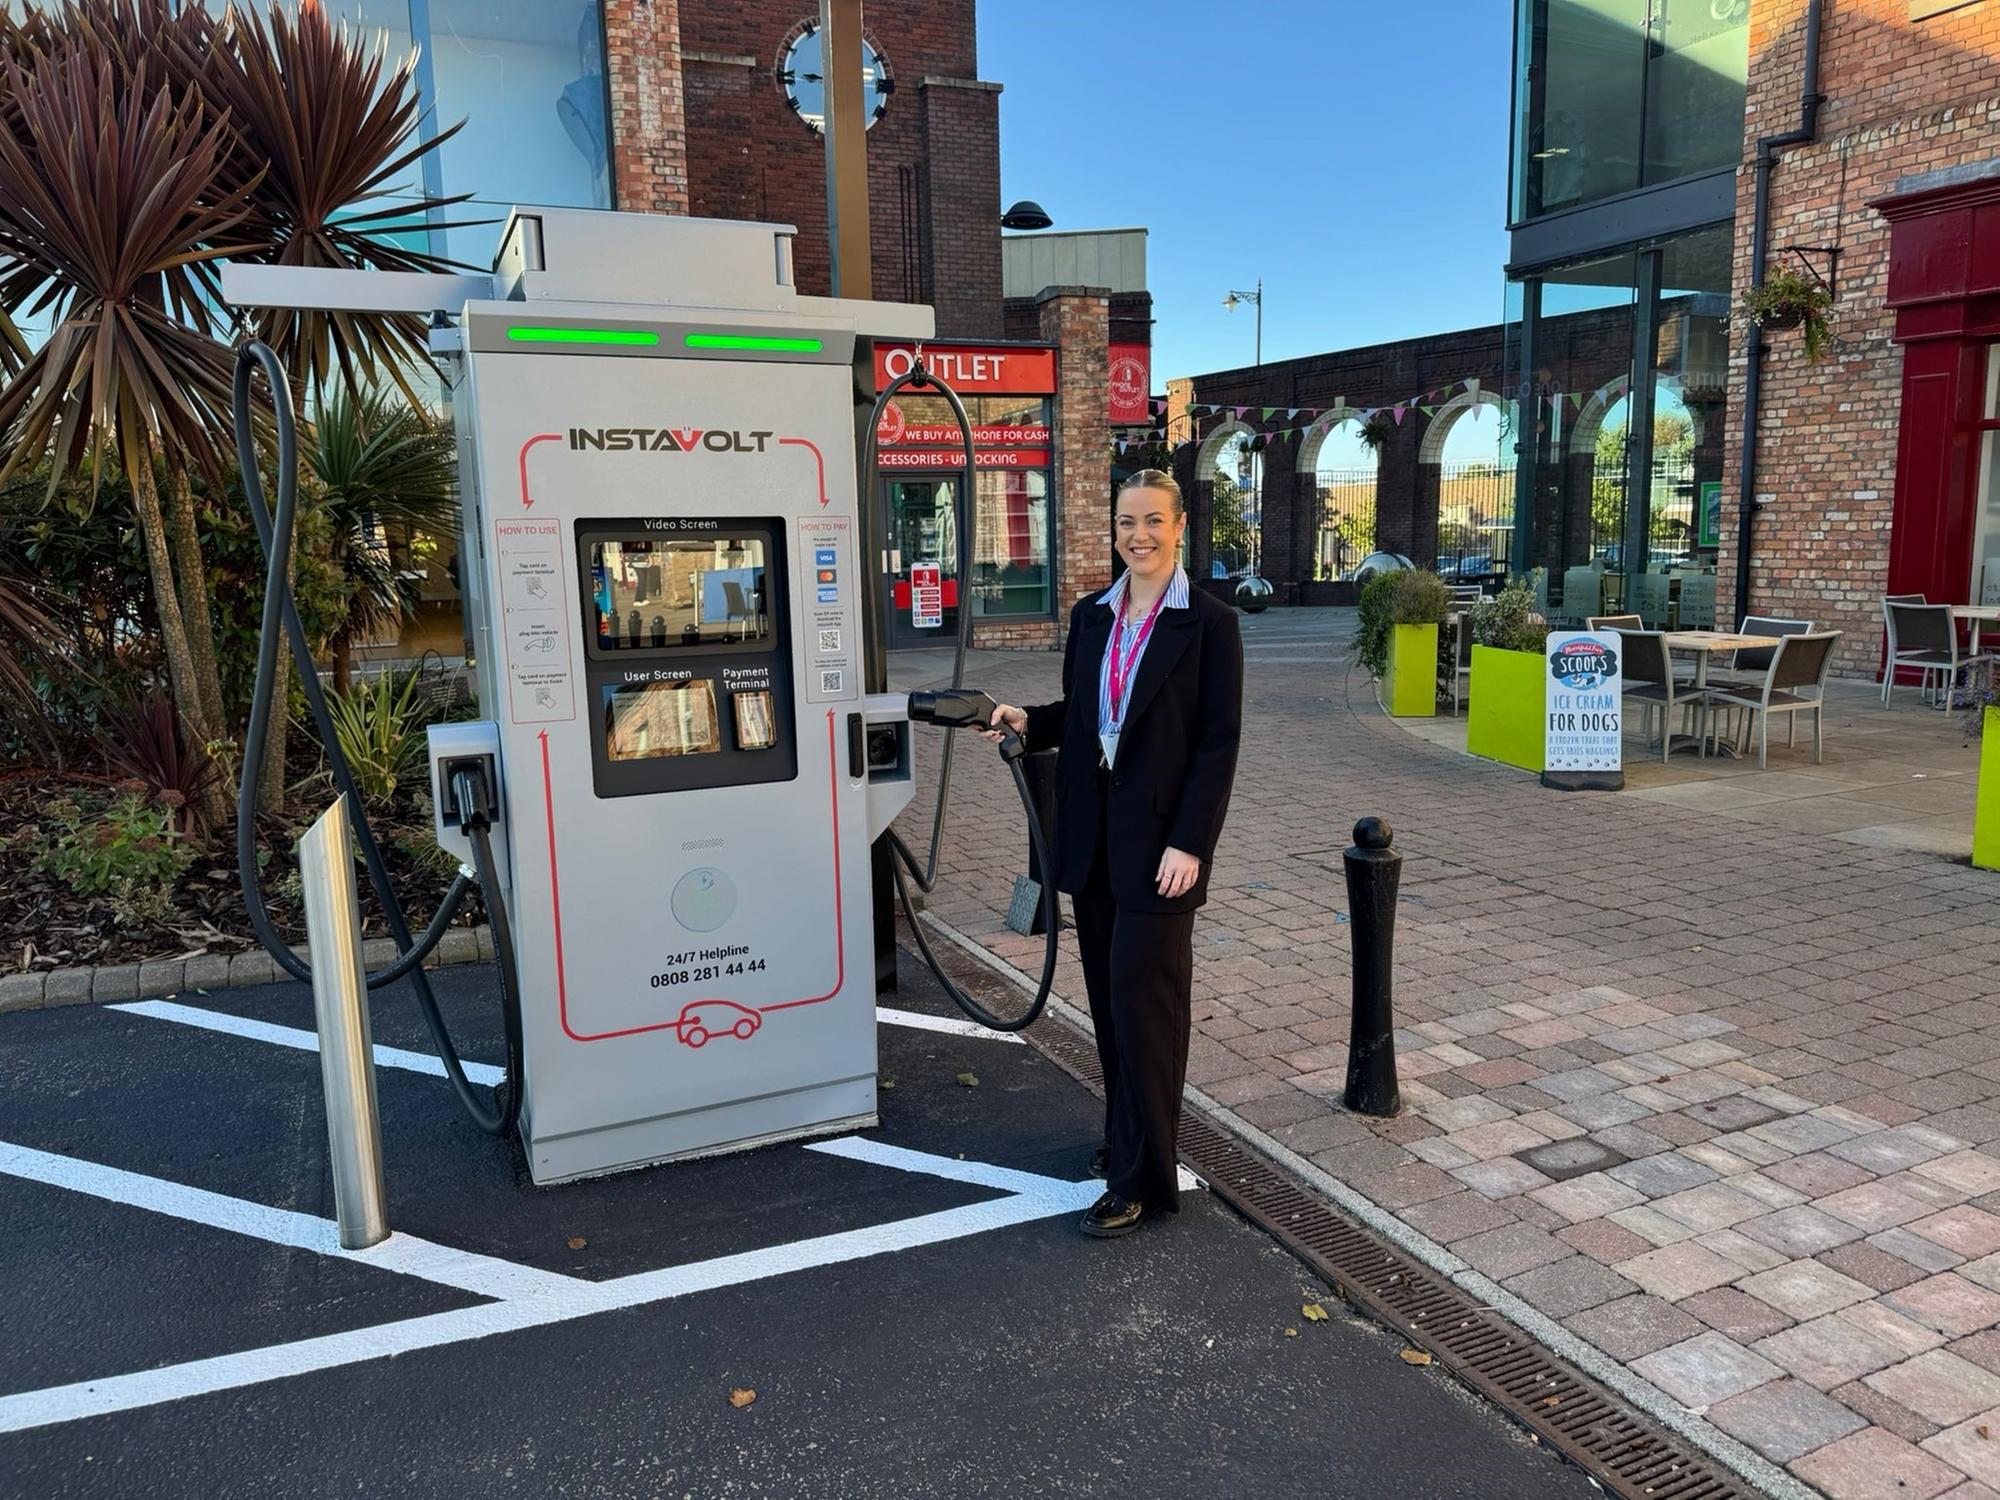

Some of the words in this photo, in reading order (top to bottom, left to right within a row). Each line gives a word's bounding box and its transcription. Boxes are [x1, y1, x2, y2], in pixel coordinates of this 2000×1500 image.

[569, 426, 774, 453] INSTAVOLT
[905, 430, 921, 440] WE
[923, 430, 943, 440] BUY
[973, 430, 1001, 440] HONE
[1003, 430, 1023, 440] FOR
[1024, 430, 1049, 440] CASH
[878, 454, 944, 465] CCESSORIES
[951, 453, 1017, 465] UNOCKING
[500, 526, 521, 535] HOW
[524, 526, 537, 535] TO
[539, 526, 558, 535] USE
[644, 519, 676, 530] Video
[680, 519, 718, 530] Screen
[800, 523, 820, 531] HOW
[822, 523, 832, 531] TO
[833, 522, 848, 530] PAY
[1560, 655, 1608, 673] SCOOP'S
[624, 672, 651, 682] User
[654, 669, 692, 680] Screen
[722, 667, 769, 680] Payment
[723, 678, 770, 690] Terminal
[1554, 694, 1571, 710] ICE
[1576, 694, 1614, 710] CREAM
[1549, 713, 1576, 732] FOR
[1581, 713, 1619, 732] DOGS
[1555, 735, 1579, 745] FROZEN
[1602, 735, 1618, 745] THAT
[666, 951, 696, 966] 24/7
[699, 945, 750, 960] Helpline
[650, 970, 690, 988] 0808
[693, 965, 720, 982] 281
[725, 962, 744, 976] 44
[747, 958, 767, 972] 44
